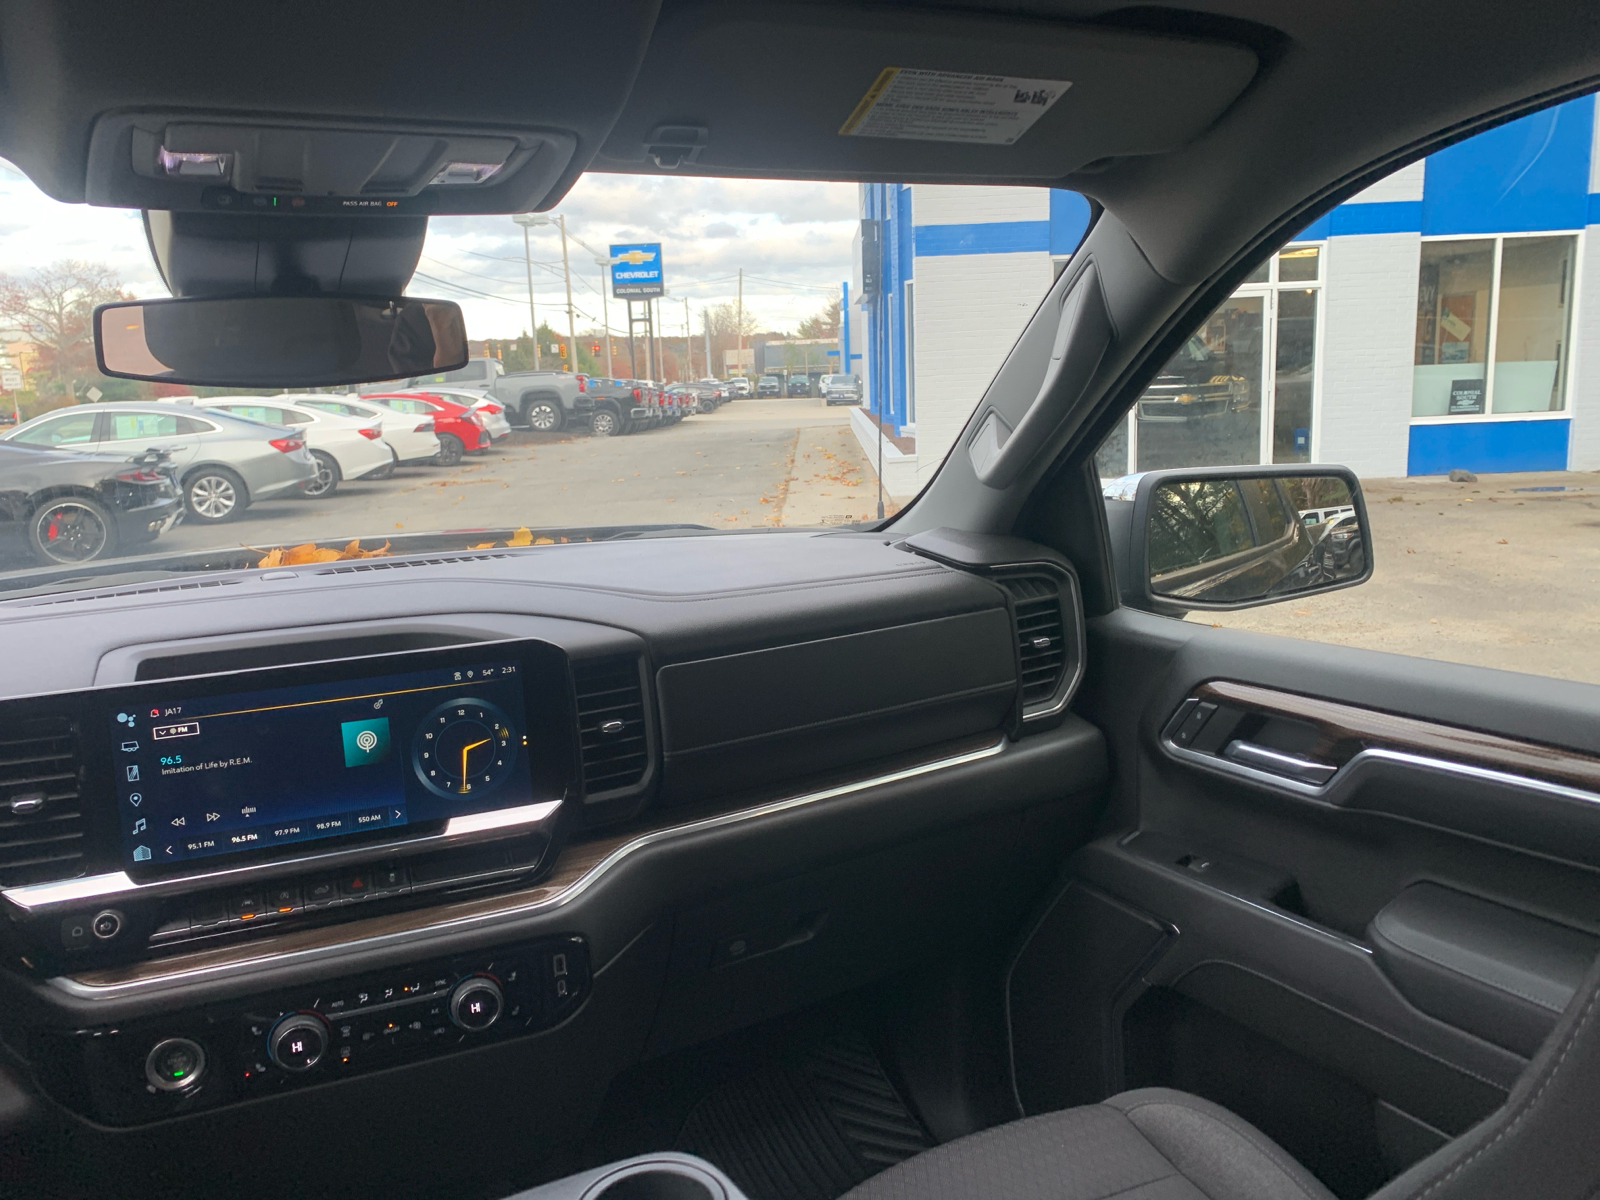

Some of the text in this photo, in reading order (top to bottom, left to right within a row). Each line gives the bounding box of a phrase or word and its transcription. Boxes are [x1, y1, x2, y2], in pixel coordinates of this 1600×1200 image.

[615, 270, 659, 280] CHEVROLET
[164, 707, 182, 717] JA17
[160, 755, 182, 765] 96.5
[162, 766, 195, 775] Imitation
[205, 761, 218, 769] Life
[219, 760, 228, 768] by
[230, 757, 252, 766] R.E.M.
[470, 1002, 480, 1014] HI
[292, 1041, 303, 1053] HI
